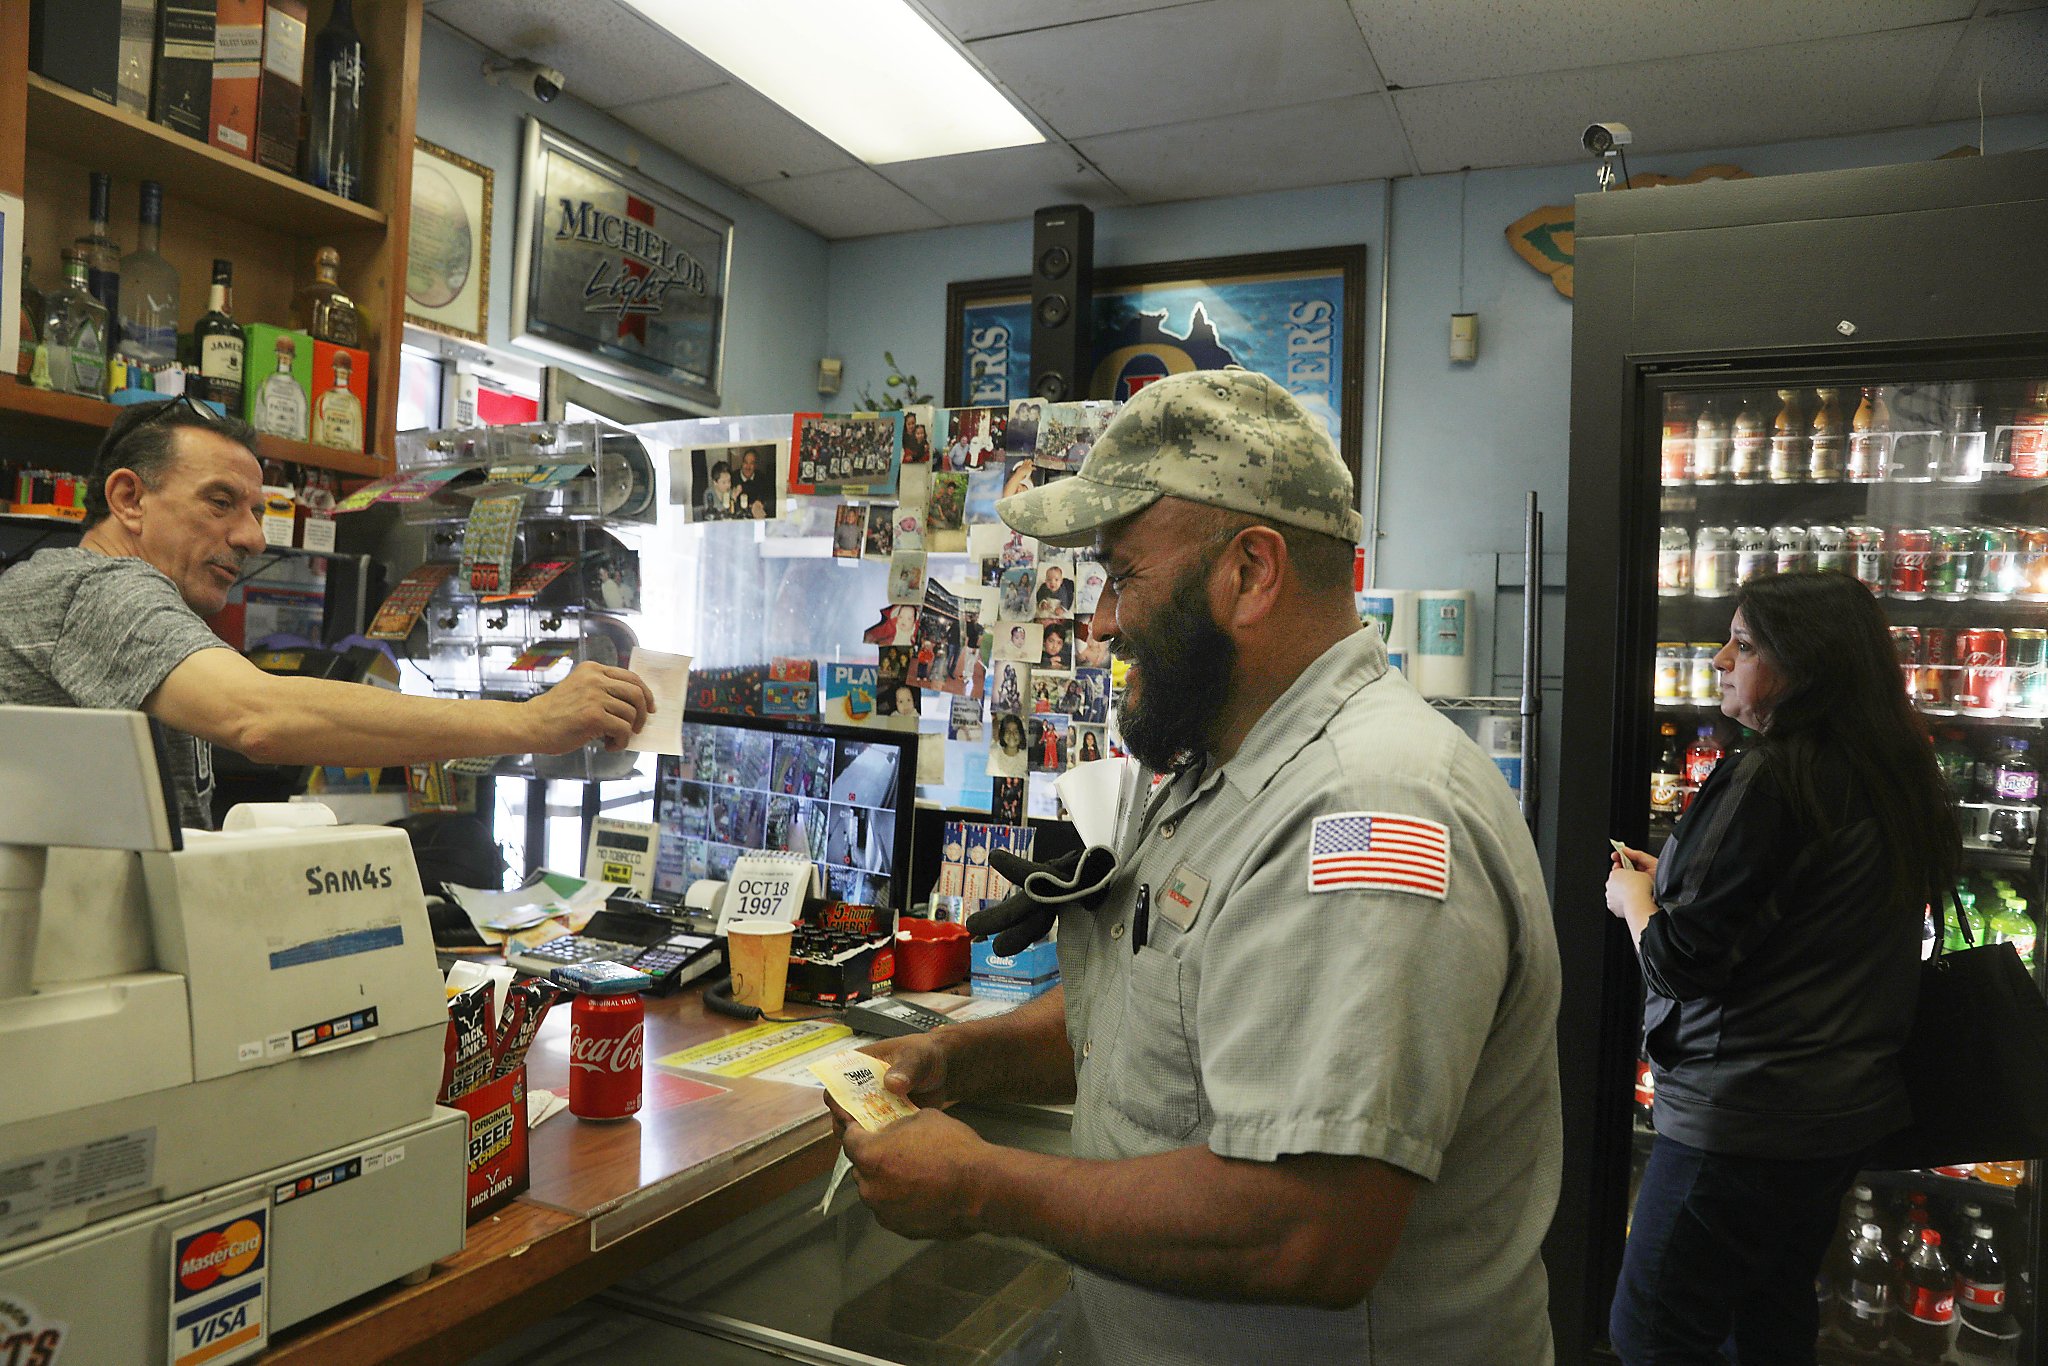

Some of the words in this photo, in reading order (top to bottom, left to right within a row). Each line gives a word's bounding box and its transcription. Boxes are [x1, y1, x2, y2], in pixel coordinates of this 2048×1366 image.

[555, 198, 706, 296] MICHELOB
[584, 260, 686, 320] Light
[835, 666, 878, 685] PLAY
[305, 863, 393, 896] SAM4S
[737, 897, 782, 916] 1997
[834, 902, 875, 919] 5-hour
[588, 999, 620, 1007] ORIGINAL
[456, 1035, 488, 1063] LINK'S
[460, 1025, 483, 1049] JACK
[474, 1107, 509, 1132] ORIGINAL
[469, 1116, 514, 1162] BEEF
[479, 1135, 512, 1166] CHEESE
[471, 1189, 489, 1209] JACK
[490, 1175, 513, 1197] LINK'S
[180, 1235, 260, 1277] MasterCard
[191, 1305, 247, 1349] VISA
